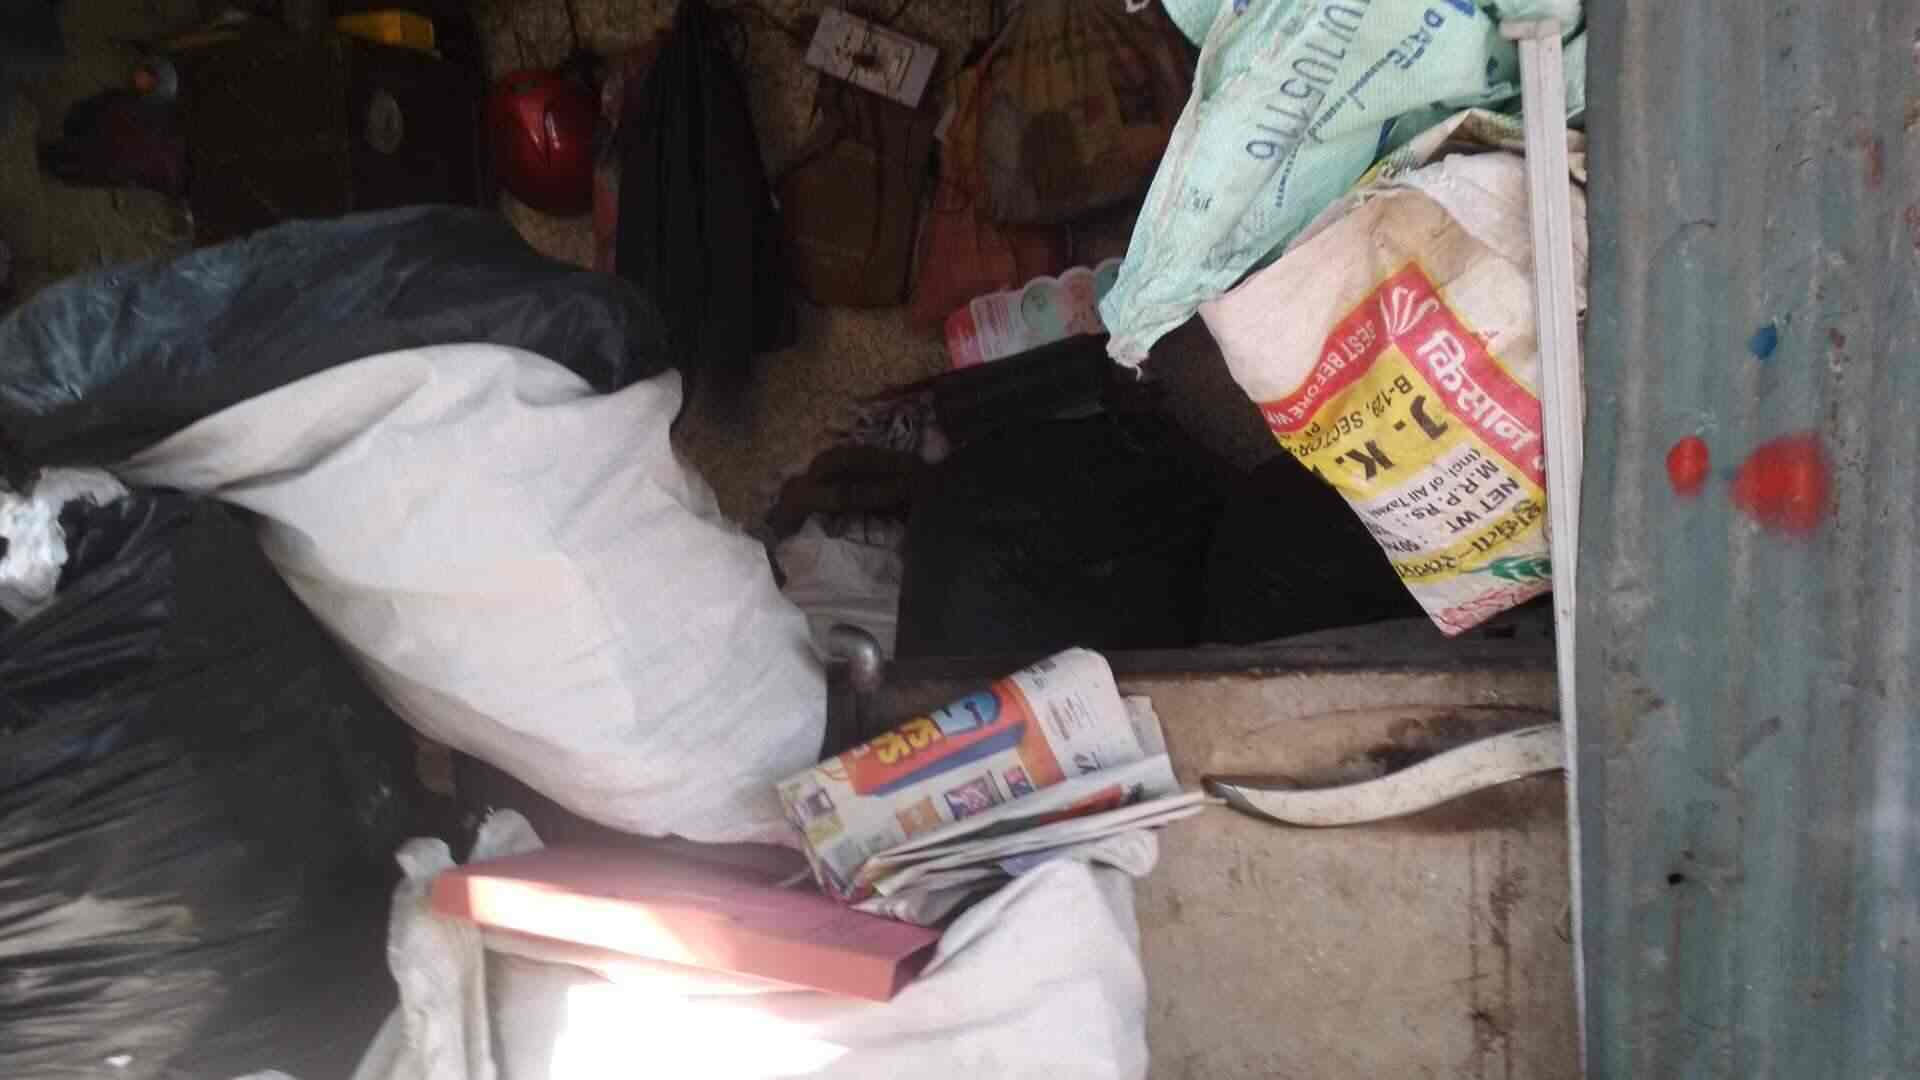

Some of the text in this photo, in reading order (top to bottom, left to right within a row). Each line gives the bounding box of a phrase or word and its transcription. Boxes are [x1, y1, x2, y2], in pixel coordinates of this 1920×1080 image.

[1287, 351, 1346, 421] BEFORE
[1416, 329, 1538, 453] किसान
[1334, 439, 1395, 482] K.
[1407, 484, 1429, 503] All
[1429, 475, 1446, 493] of
[1437, 459, 1500, 507] M.R.P.
[1480, 476, 1520, 513] NET
[1446, 509, 1482, 534] WT
